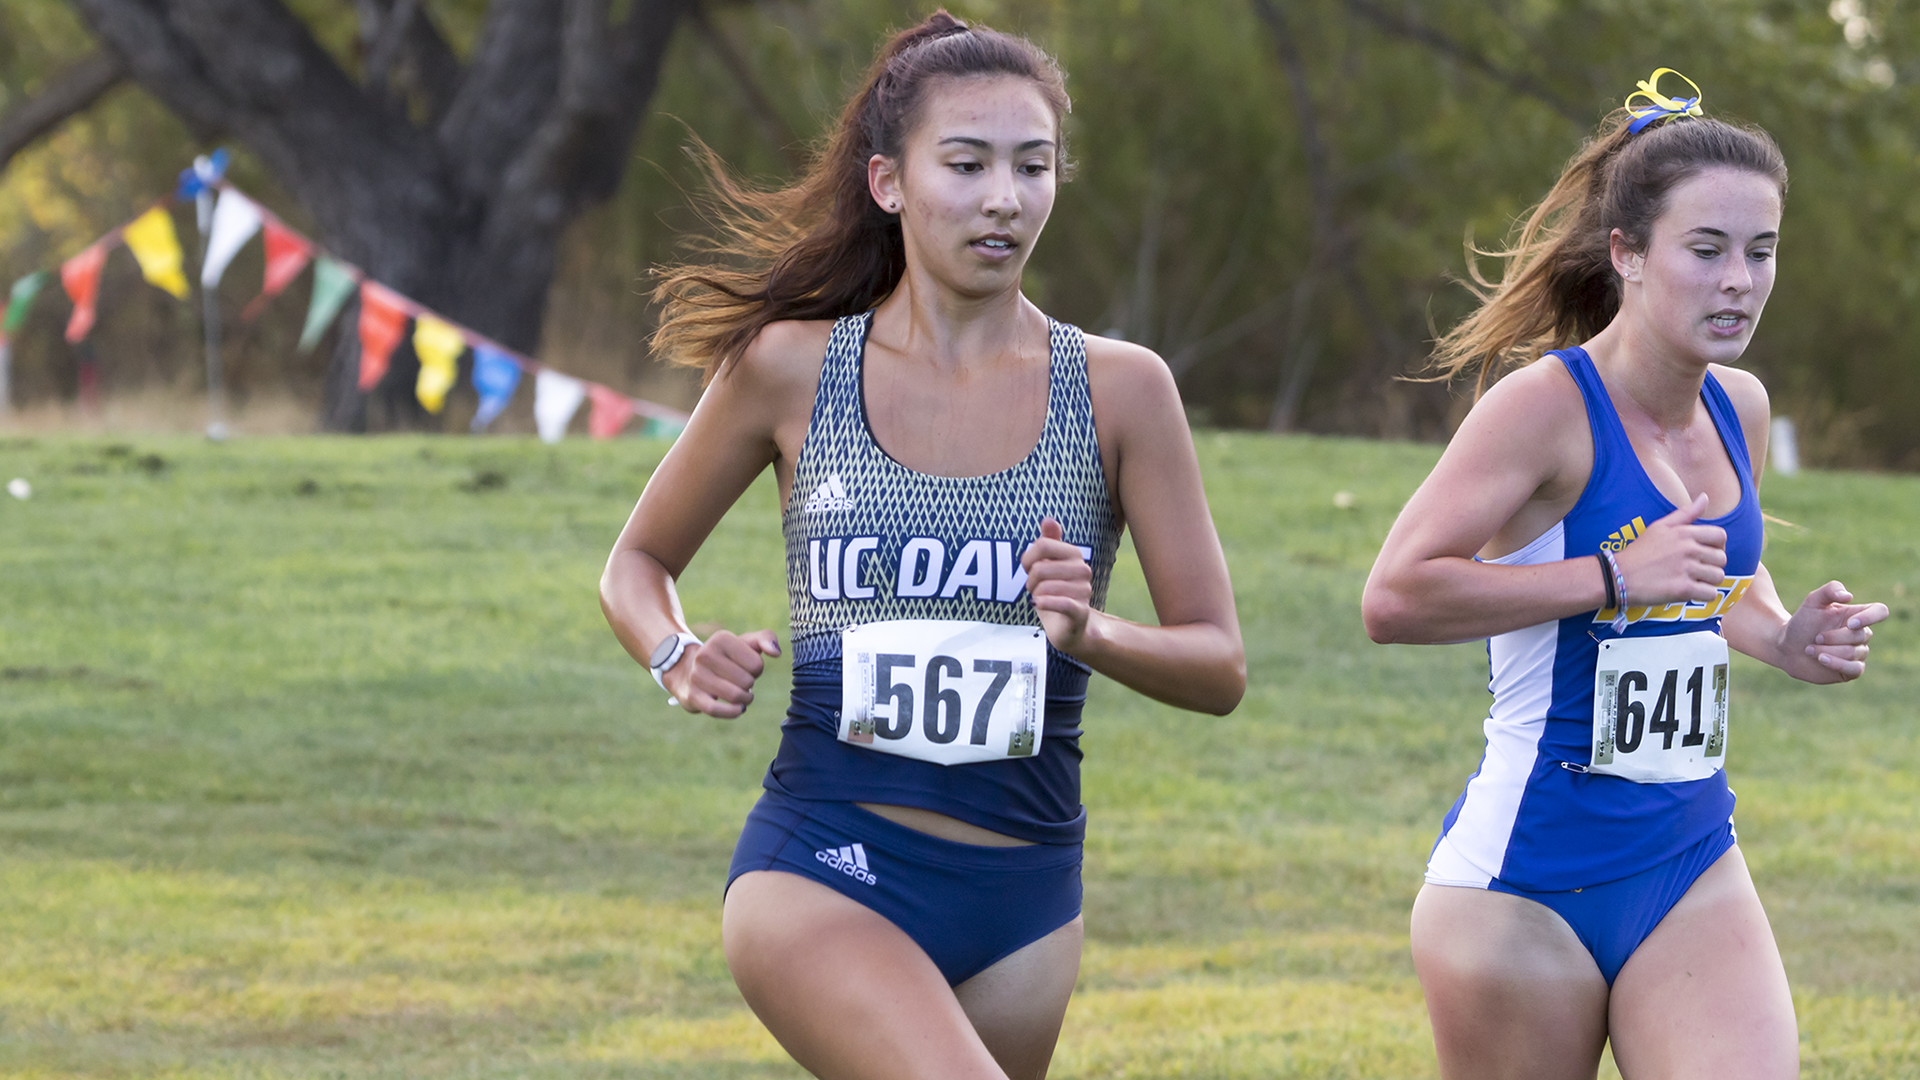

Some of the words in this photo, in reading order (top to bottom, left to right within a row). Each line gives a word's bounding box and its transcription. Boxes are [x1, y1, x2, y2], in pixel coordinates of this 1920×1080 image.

[804, 497, 853, 514] adidas
[810, 536, 879, 600] UC
[896, 537, 1092, 603] DAV
[873, 653, 1012, 746] 567
[1615, 666, 1705, 753] 641
[815, 850, 877, 886] adidas
